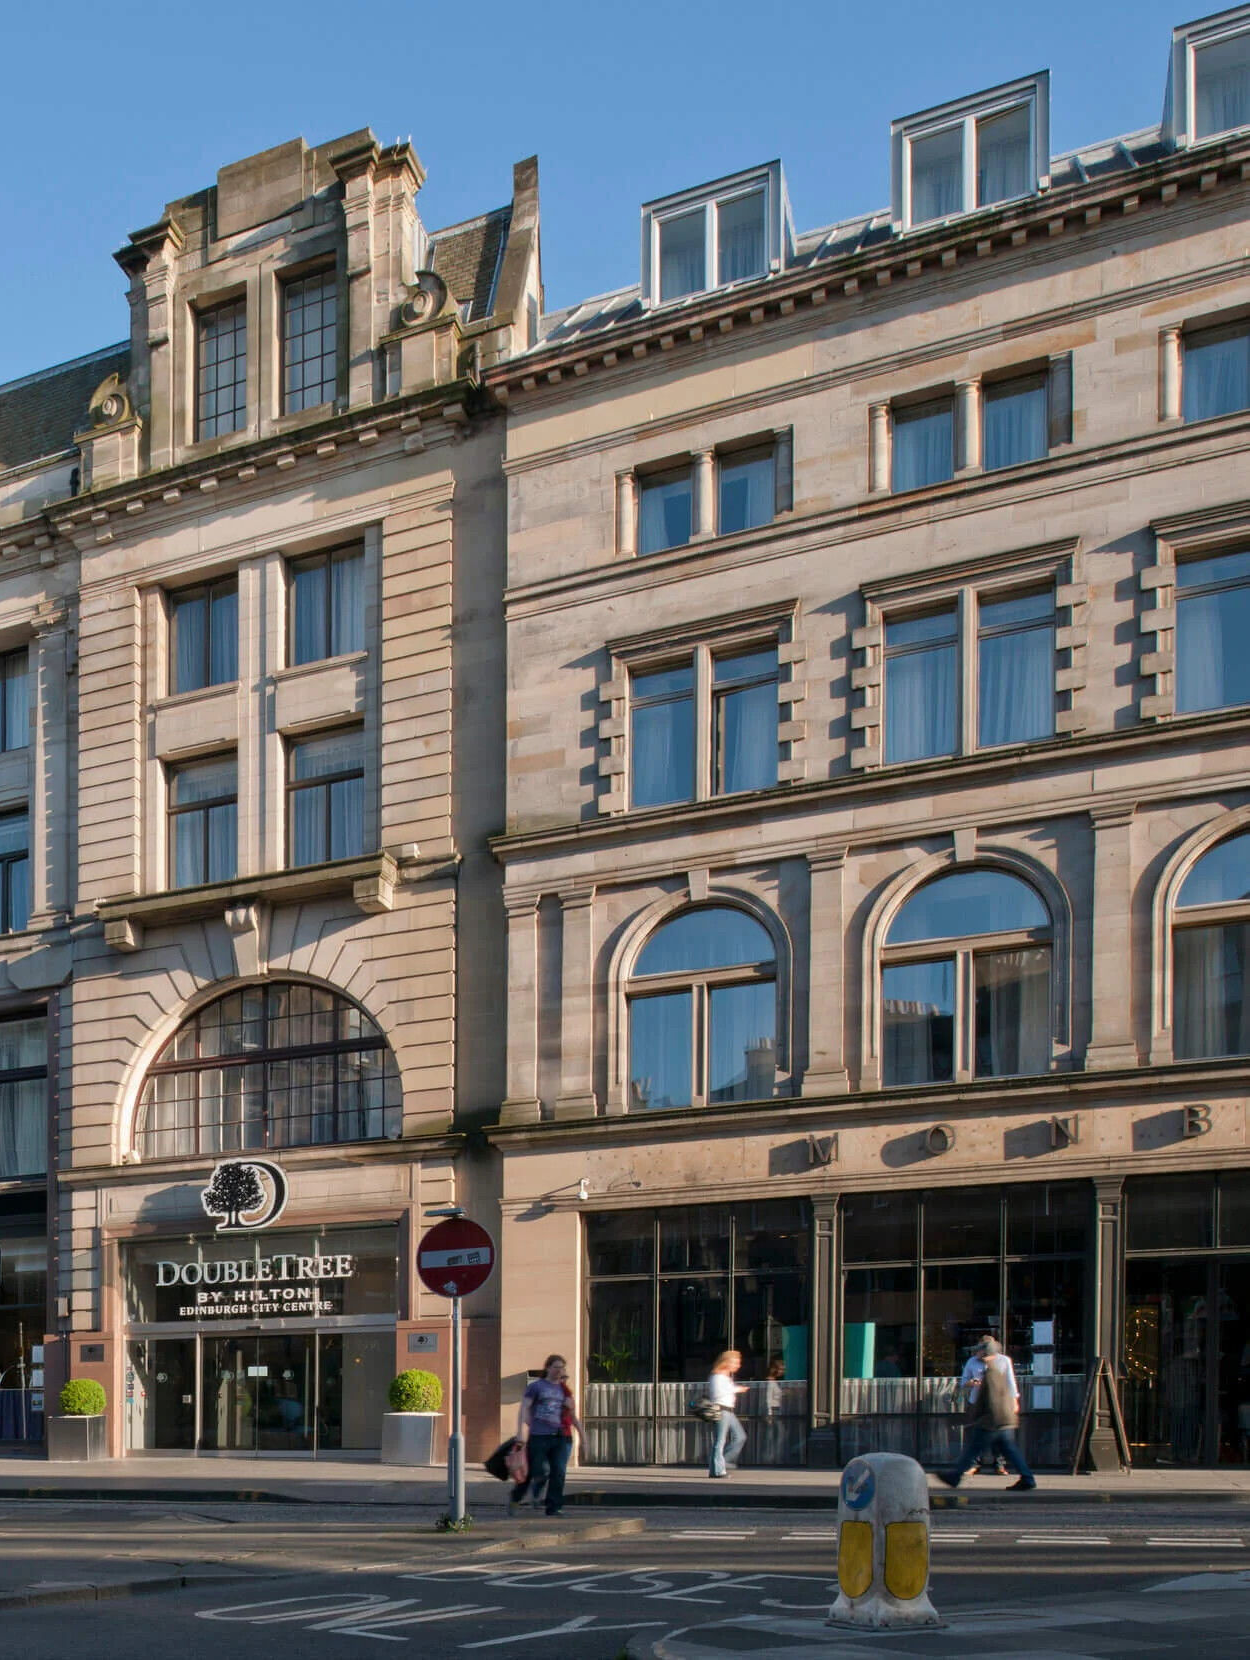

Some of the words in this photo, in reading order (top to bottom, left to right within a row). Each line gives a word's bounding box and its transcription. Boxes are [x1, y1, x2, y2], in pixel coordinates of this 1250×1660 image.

[197, 1291, 221, 1303] BY
[234, 1287, 311, 1302] HILTON
[179, 1303, 248, 1316] EDINBURGH
[251, 1302, 280, 1314] CITY
[283, 1300, 332, 1312] CENTRE
[194, 1593, 668, 1649] ONLY
